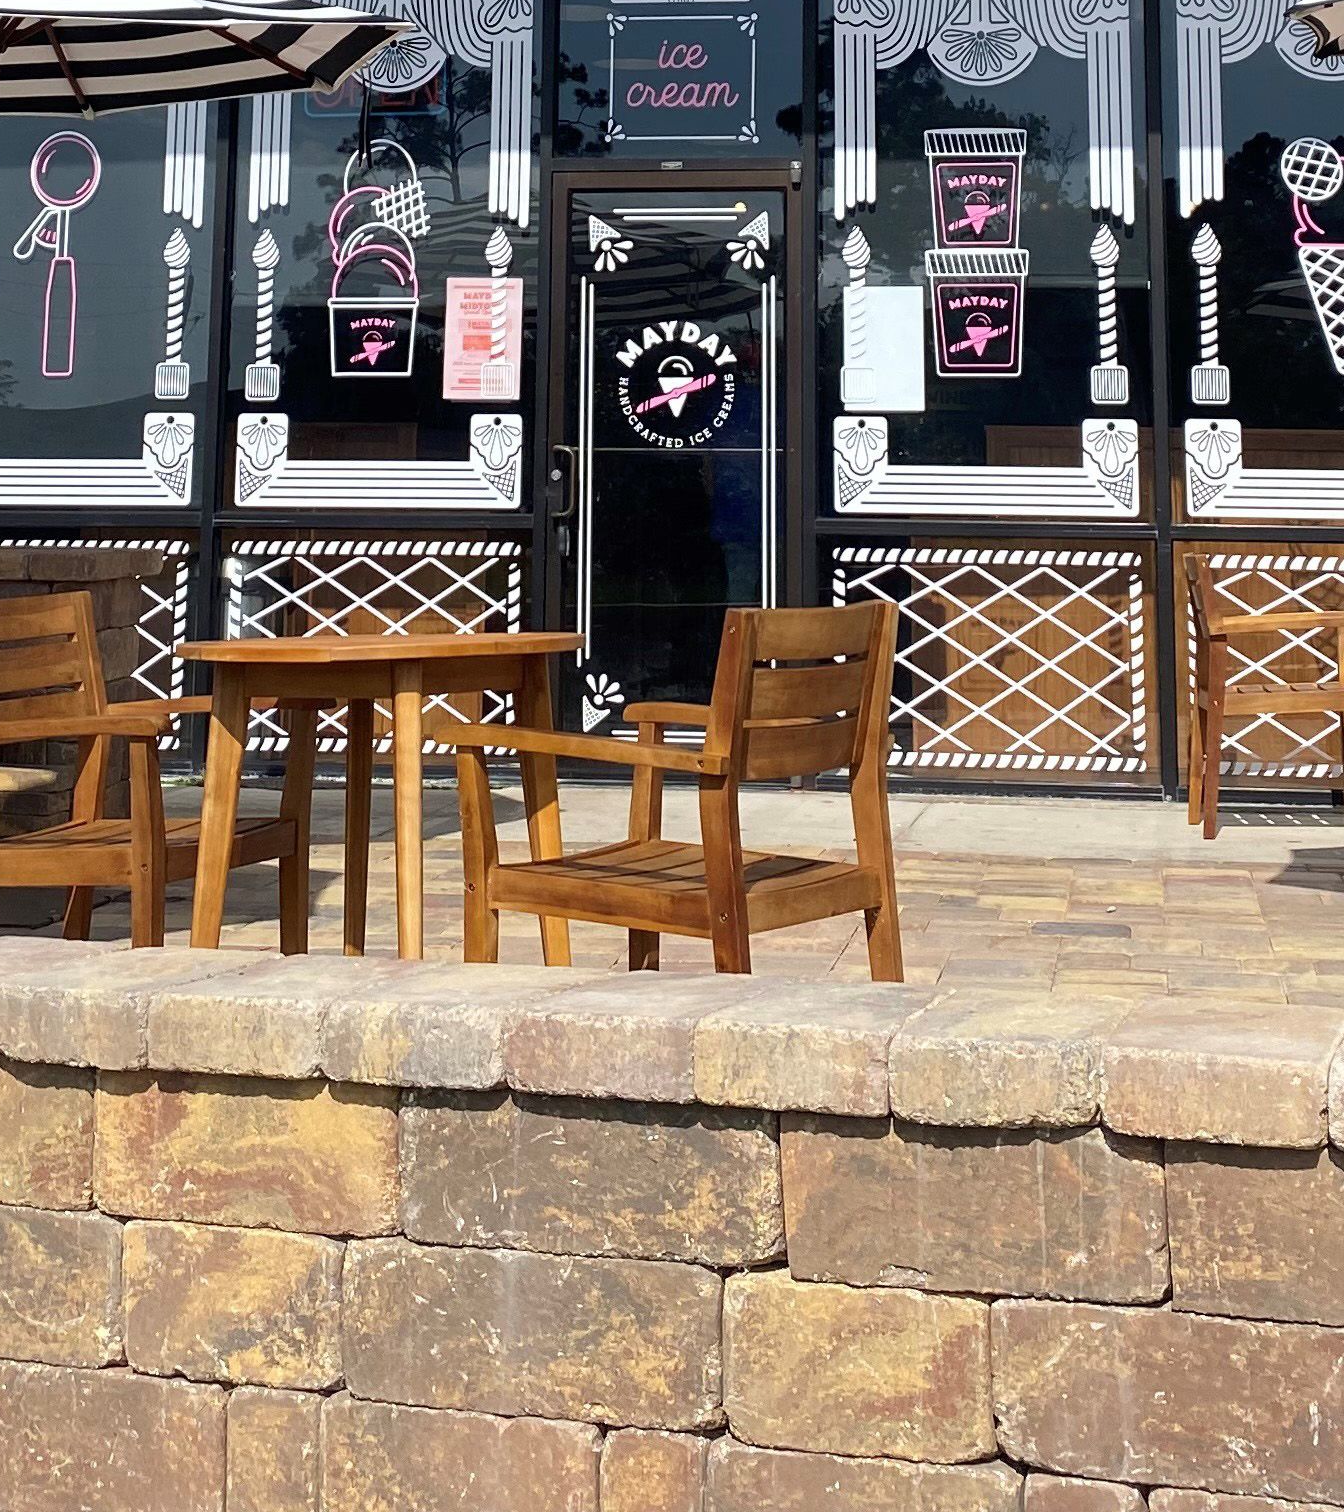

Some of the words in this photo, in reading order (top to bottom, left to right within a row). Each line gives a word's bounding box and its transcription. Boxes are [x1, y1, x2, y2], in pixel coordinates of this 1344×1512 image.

[658, 39, 708, 70] ice
[626, 81, 739, 108] cream
[947, 173, 1007, 189] MAYDAY
[948, 295, 1009, 310] MAYDAY
[350, 318, 396, 330] MAYDAY
[616, 319, 738, 368] MAYDAY
[618, 376, 684, 449] HANDCRAFTED
[688, 426, 714, 446] ICE
[712, 373, 735, 428] CREAMS
